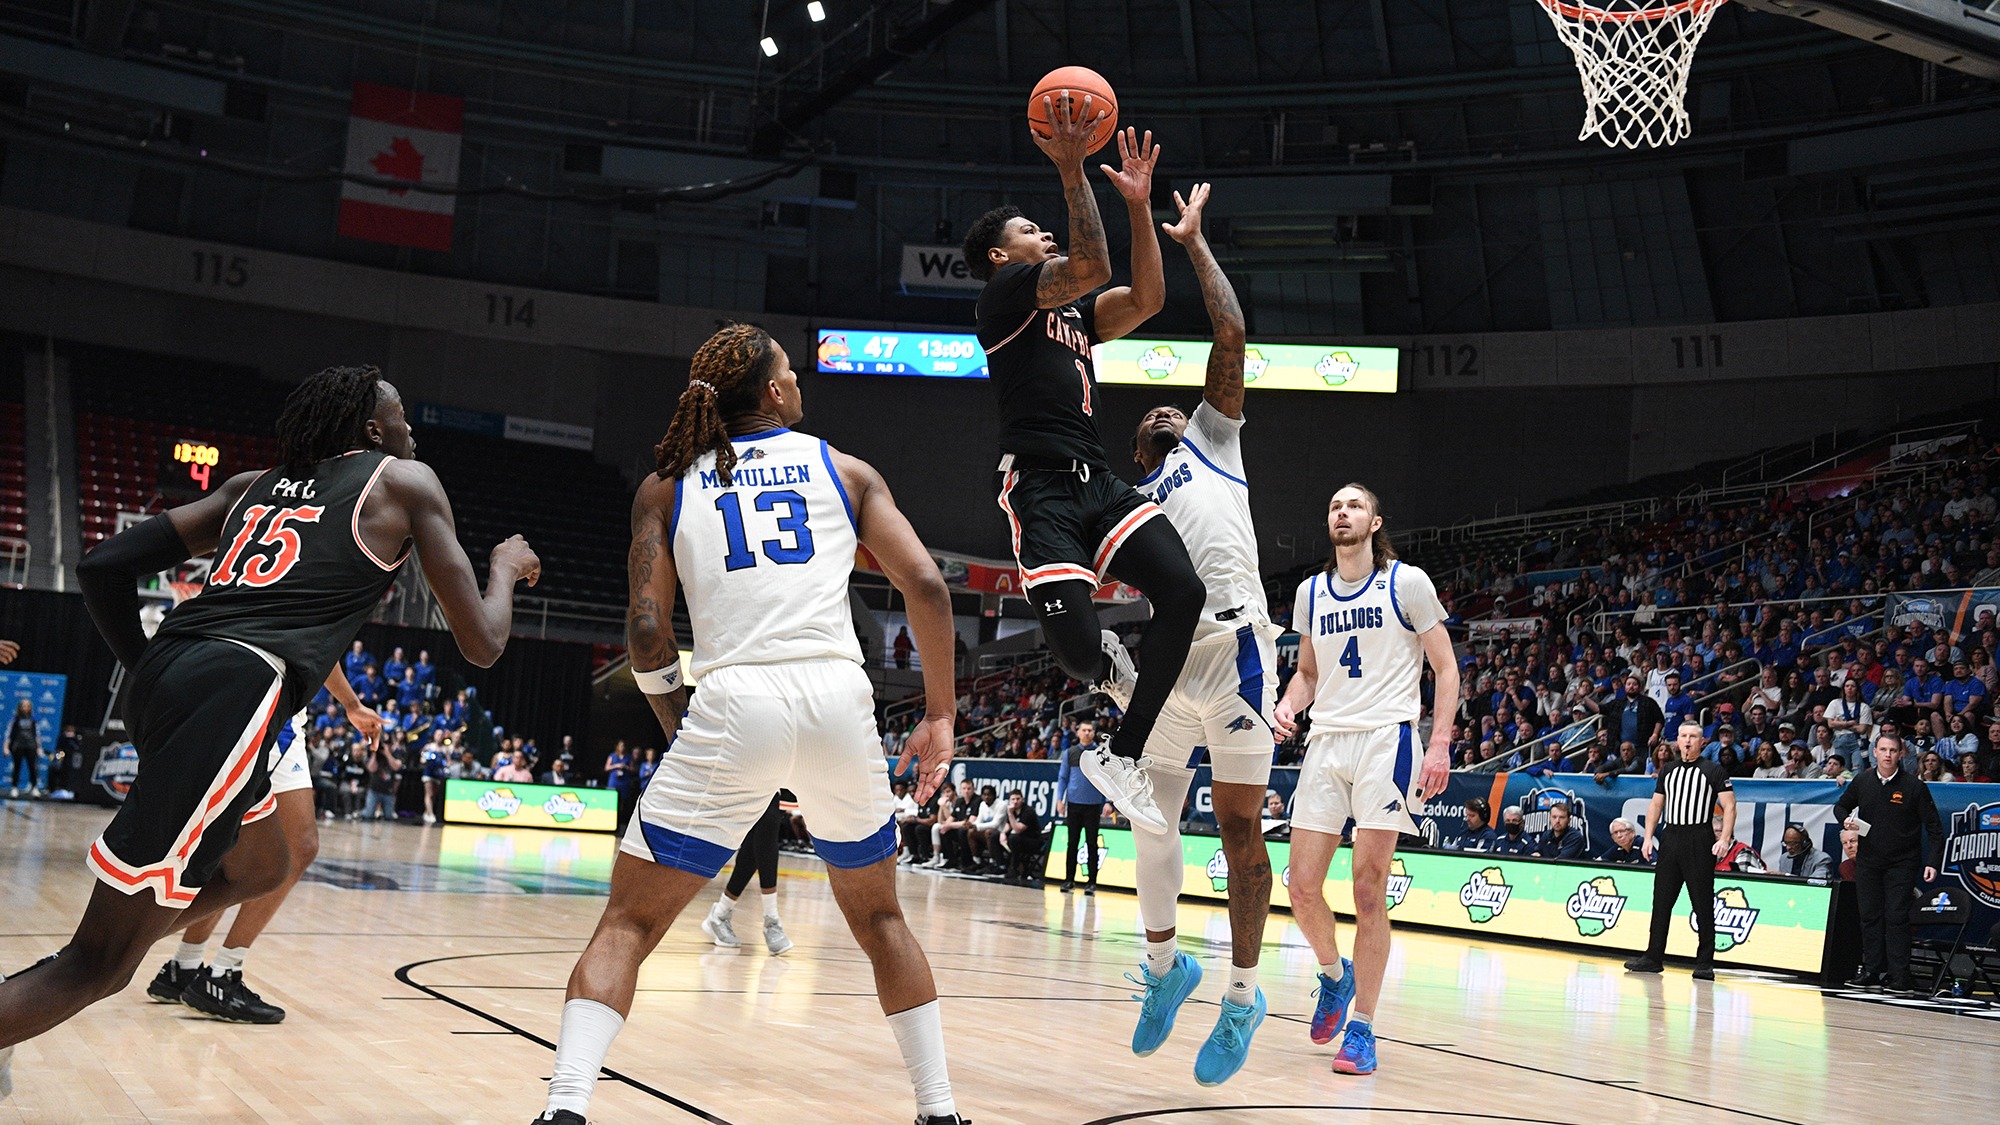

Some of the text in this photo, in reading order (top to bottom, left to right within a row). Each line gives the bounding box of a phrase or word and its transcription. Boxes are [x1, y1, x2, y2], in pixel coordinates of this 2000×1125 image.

[194, 252, 248, 288] 115
[486, 293, 536, 328] 114
[864, 336, 975, 359] 47 13:00
[1422, 344, 1479, 376] 112
[1671, 335, 1724, 369] 111
[1075, 359, 1093, 417] 1
[174, 443, 220, 466] 13:00
[190, 463, 211, 491] 4
[272, 477, 316, 499] PAL
[209, 504, 325, 588] 15
[715, 489, 816, 572] 13
[1320, 606, 1384, 636] BULLDOGS
[1339, 635, 1362, 678] 4
[1459, 870, 1513, 917] Starry
[1566, 880, 1629, 930] Starry
